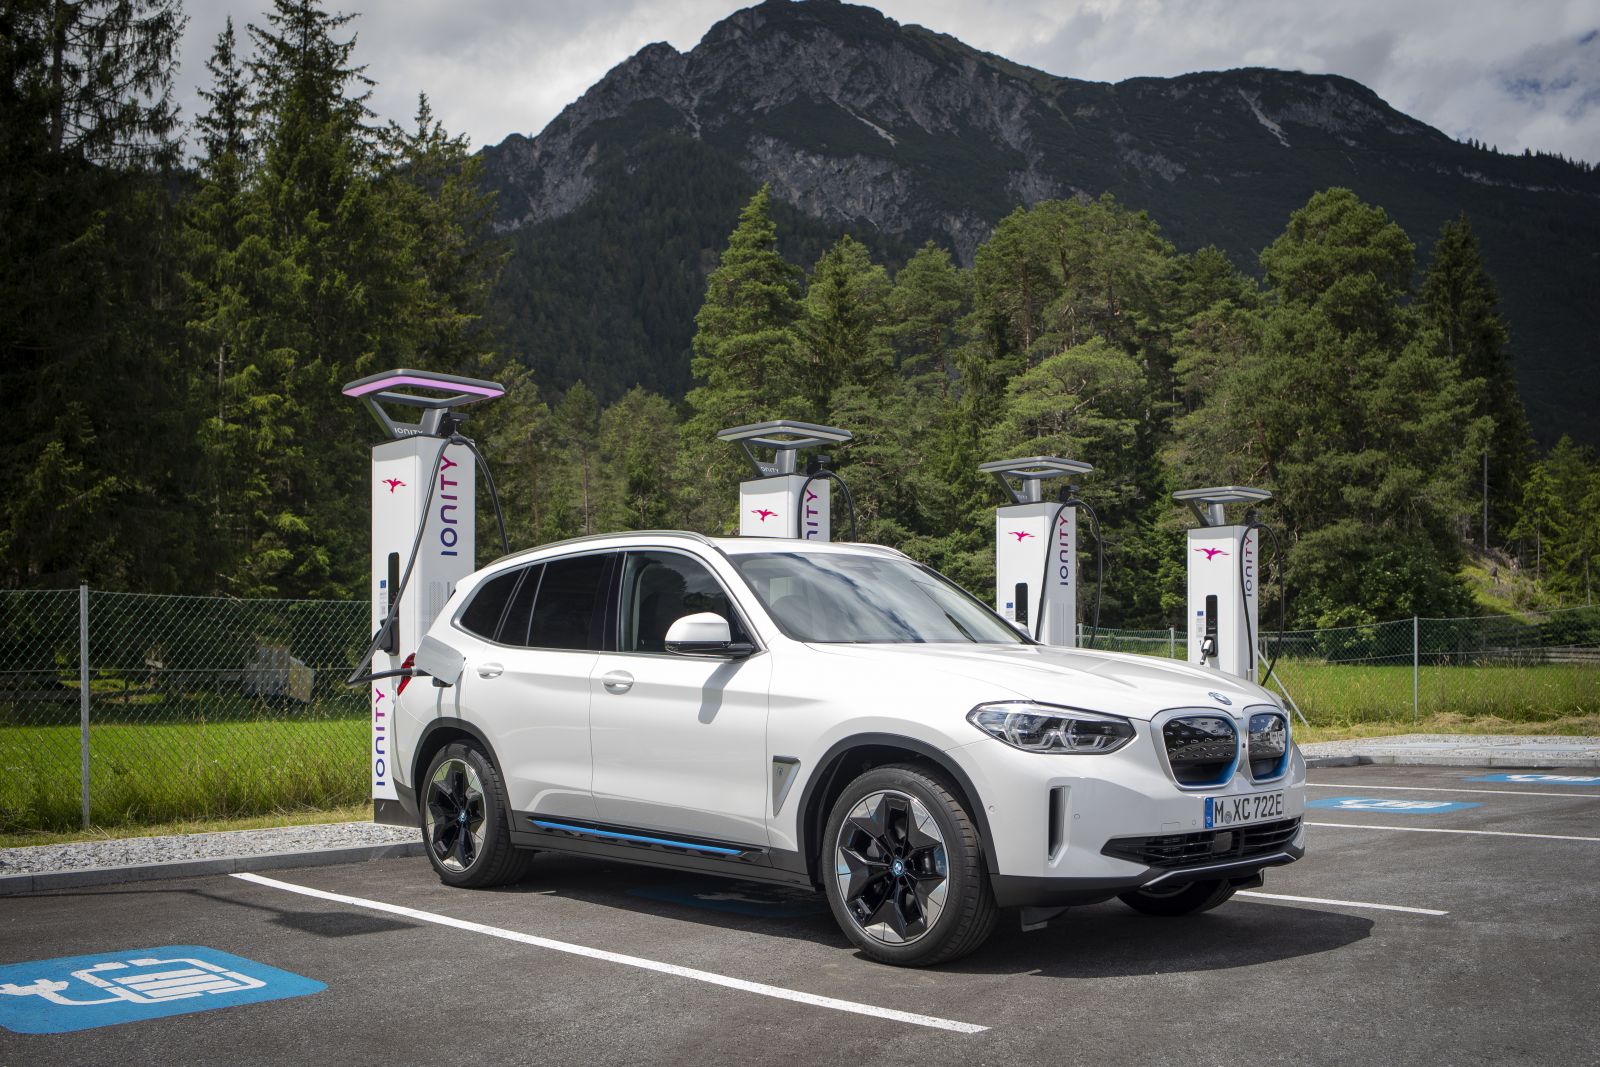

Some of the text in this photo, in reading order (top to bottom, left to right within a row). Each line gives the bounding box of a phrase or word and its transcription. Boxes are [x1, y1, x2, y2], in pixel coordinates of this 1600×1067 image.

[440, 454, 458, 556] IONITY
[1059, 514, 1069, 586] IONITY
[1245, 536, 1253, 597] IONITY
[375, 687, 386, 786] IONITY
[1214, 794, 1283, 824] M XC 722E
